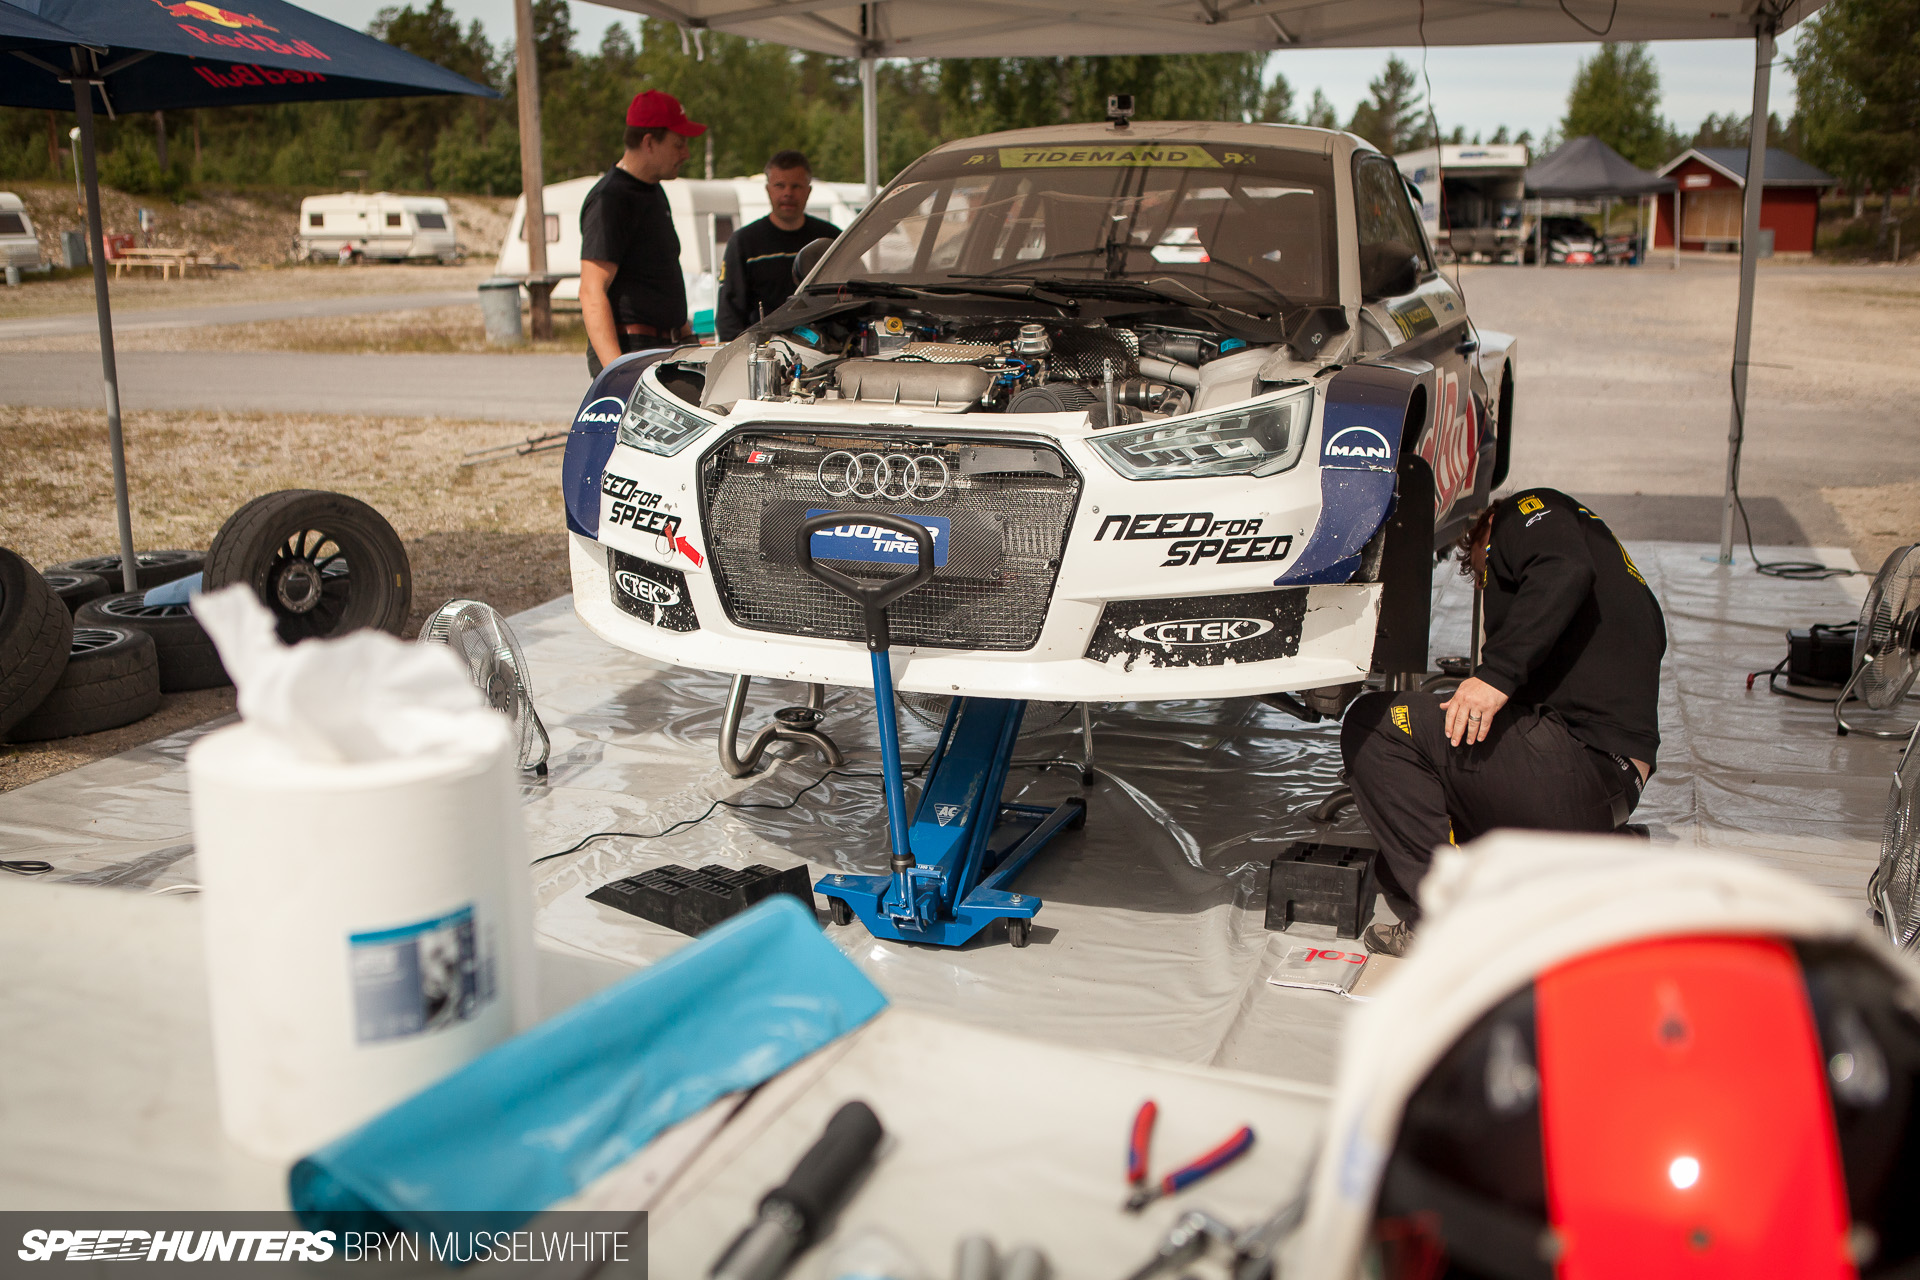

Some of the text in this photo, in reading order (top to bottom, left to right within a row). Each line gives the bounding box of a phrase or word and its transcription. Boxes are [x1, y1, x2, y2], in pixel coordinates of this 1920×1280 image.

[177, 23, 332, 61] Red Bull
[1022, 151, 1188, 163] TIDEMAND
[582, 412, 621, 423] MAN
[754, 453, 774, 464] S1
[1331, 445, 1385, 458] MAN
[629, 489, 662, 508] FOR
[1093, 511, 1264, 542] NEED FOR
[872, 539, 921, 554] TIRE
[1159, 534, 1294, 568] SPEED
[622, 573, 661, 603] CTEK
[1156, 621, 1242, 641] CTEK
[939, 806, 957, 816] AC
